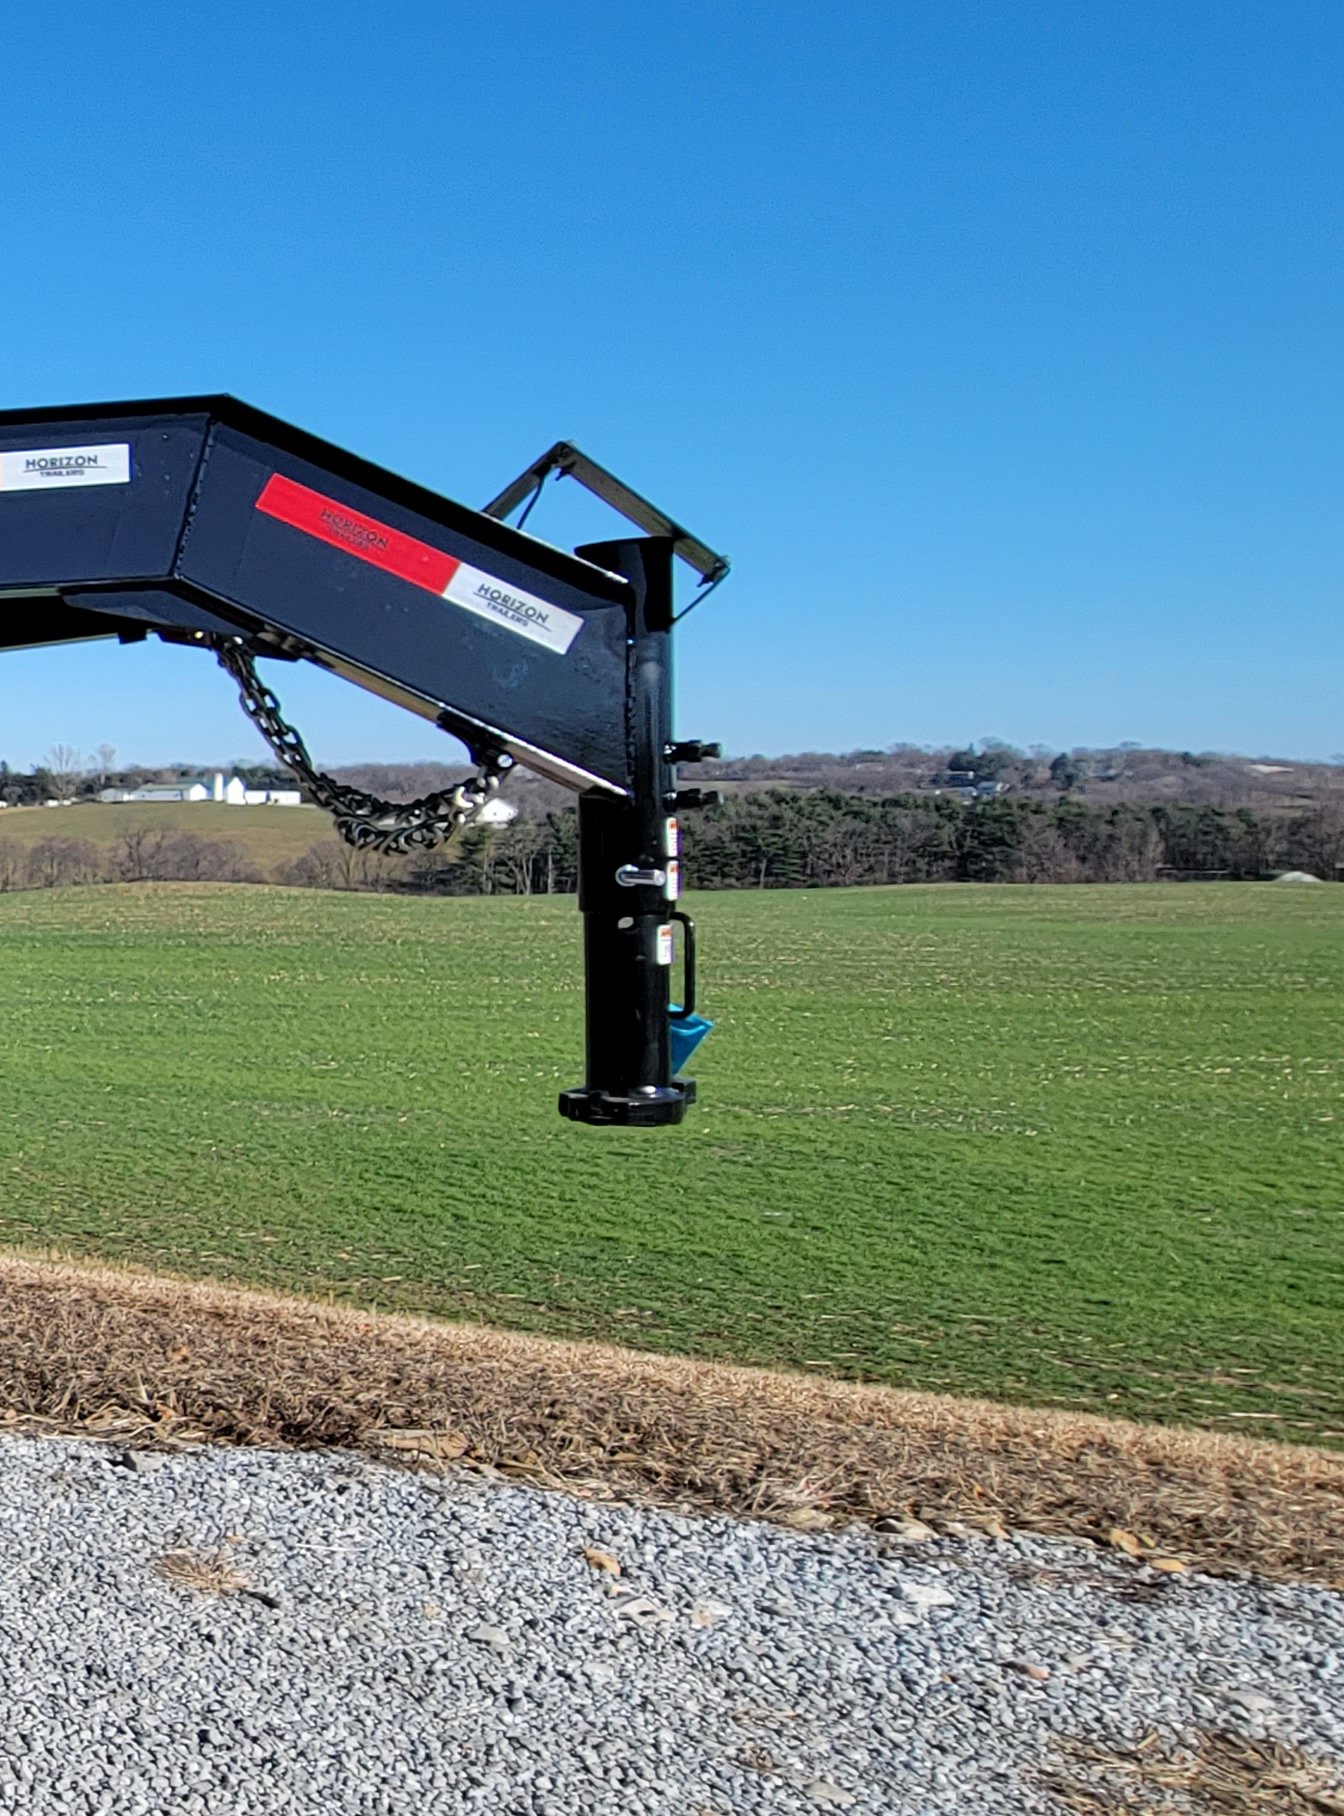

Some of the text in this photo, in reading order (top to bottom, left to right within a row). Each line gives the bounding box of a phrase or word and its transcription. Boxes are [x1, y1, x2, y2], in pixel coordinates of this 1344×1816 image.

[25, 455, 99, 469] HORIZON
[320, 507, 391, 549] HORIZON
[477, 582, 550, 624] HORIZON
